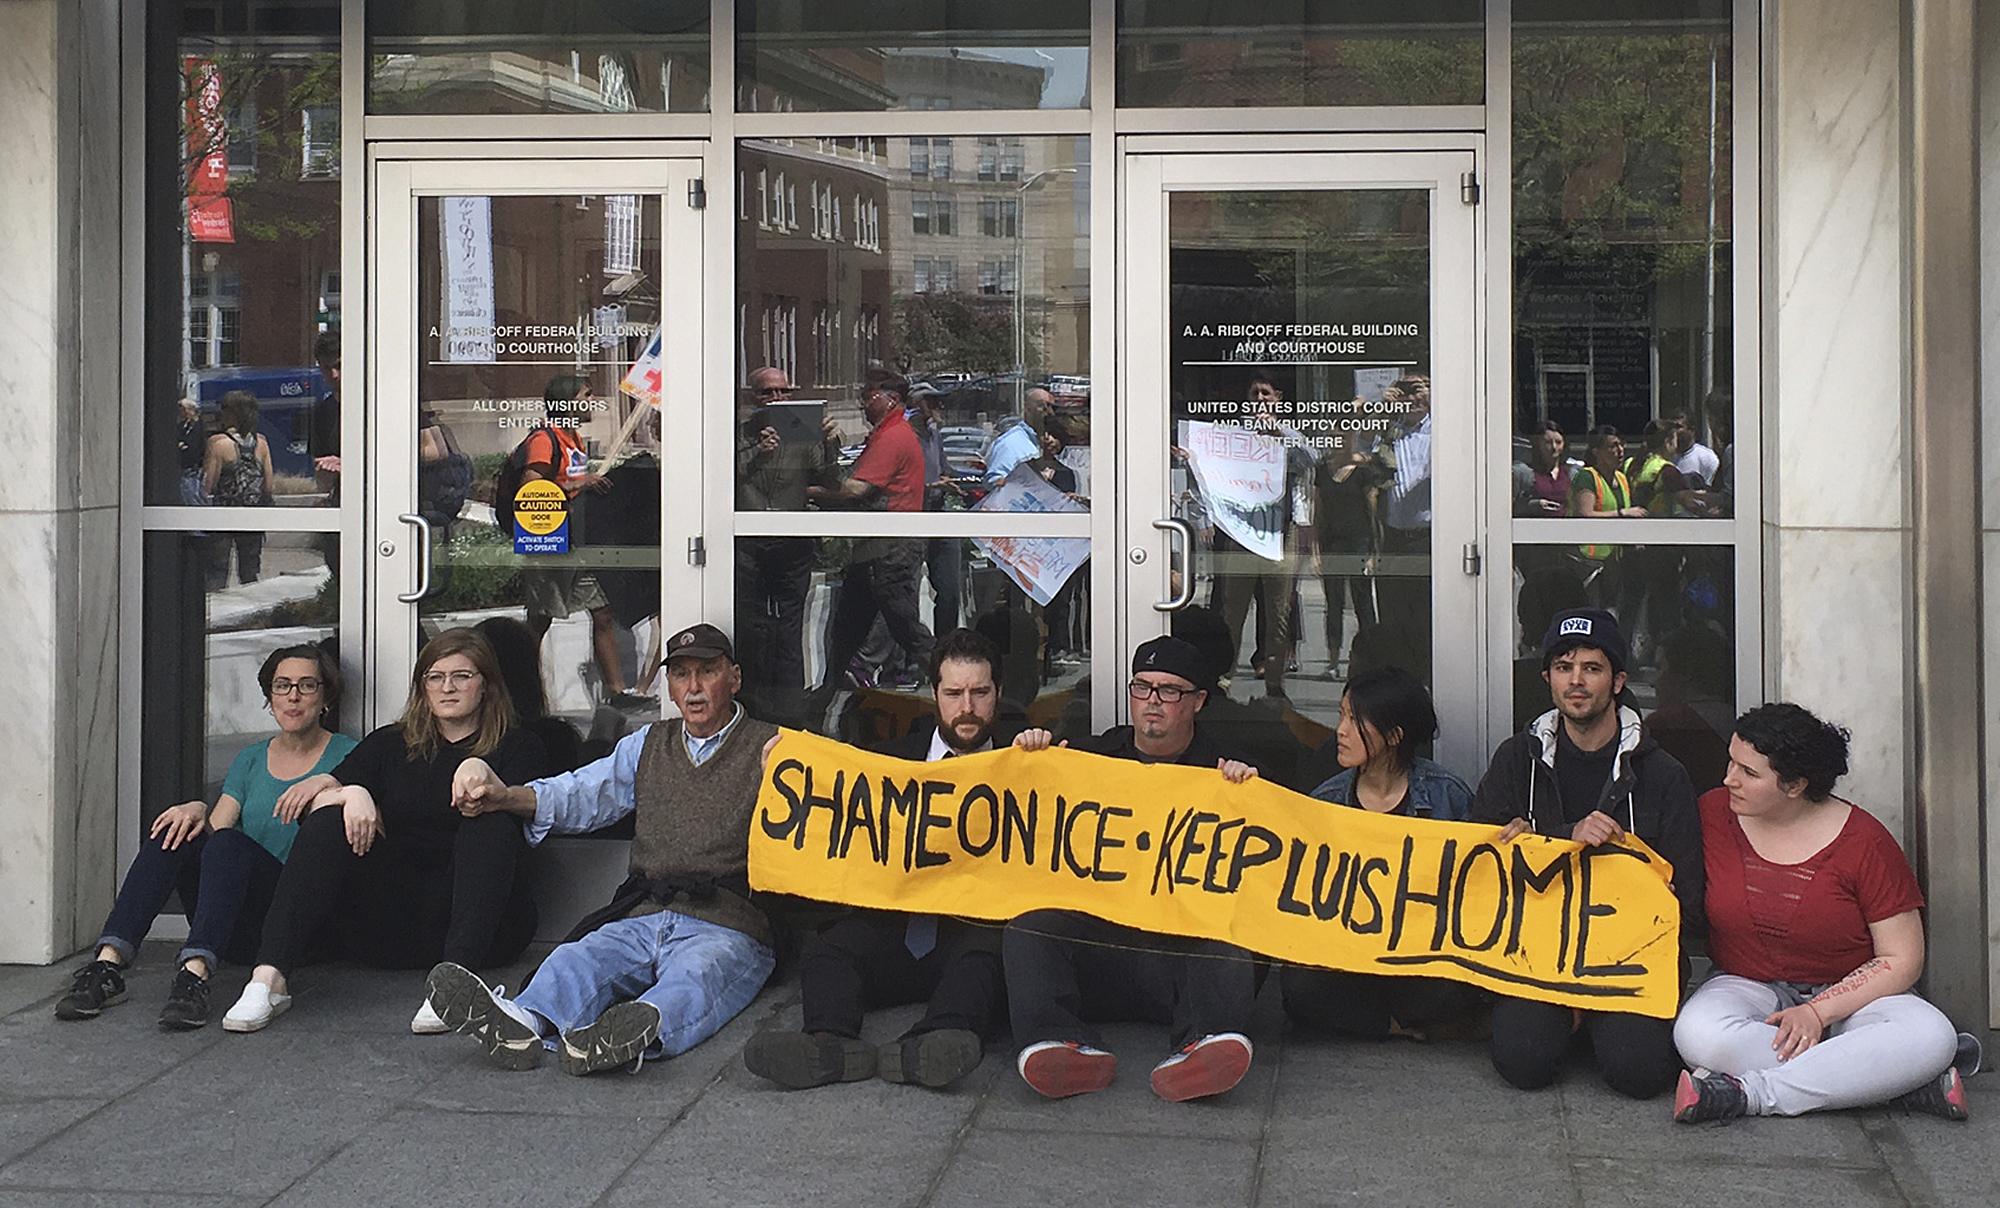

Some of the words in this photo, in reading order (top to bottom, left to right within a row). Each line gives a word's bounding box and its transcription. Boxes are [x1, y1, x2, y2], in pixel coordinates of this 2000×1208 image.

[525, 326, 582, 337] FEDERAL
[587, 325, 649, 337] BUILDING
[1183, 325, 1197, 337] A.
[1200, 325, 1214, 337] A.
[1217, 325, 1282, 337] RIBICOFF
[1286, 325, 1348, 337] FEDERAL
[1352, 324, 1418, 337] BUILDING
[509, 342, 600, 354] COURTHOUSE
[1235, 342, 1265, 354] AND
[1270, 342, 1365, 354] COURTHOUSE
[472, 400, 496, 412] ALL
[500, 400, 544, 412] OTHER
[547, 400, 607, 412] VISITORS
[1187, 402, 1237, 414] UNITED
[1241, 402, 1293, 414] STATES
[1296, 402, 1358, 414] DISTRICT
[1363, 402, 1412, 414] COURT
[498, 417, 542, 428] ENTER
[545, 417, 579, 428] HERE
[1213, 419, 1243, 431] AND
[1246, 419, 1337, 431] BANKRUPTCY
[1340, 419, 1389, 431] COURT
[1259, 436, 1301, 448] NTER
[1305, 436, 1344, 448] HERE
[522, 491, 560, 499] AUTOMATIC
[519, 501, 563, 511] CAUTION
[517, 536, 543, 544] ACTIVATE
[525, 544, 534, 552] TO
[761, 759, 956, 872] SHAME
[957, 783, 1038, 865] ON
[1050, 794, 1133, 882] ICE
[1150, 807, 1283, 896] KEEP
[1277, 837, 1391, 934] LUIS
[1387, 834, 1652, 978] HOME
